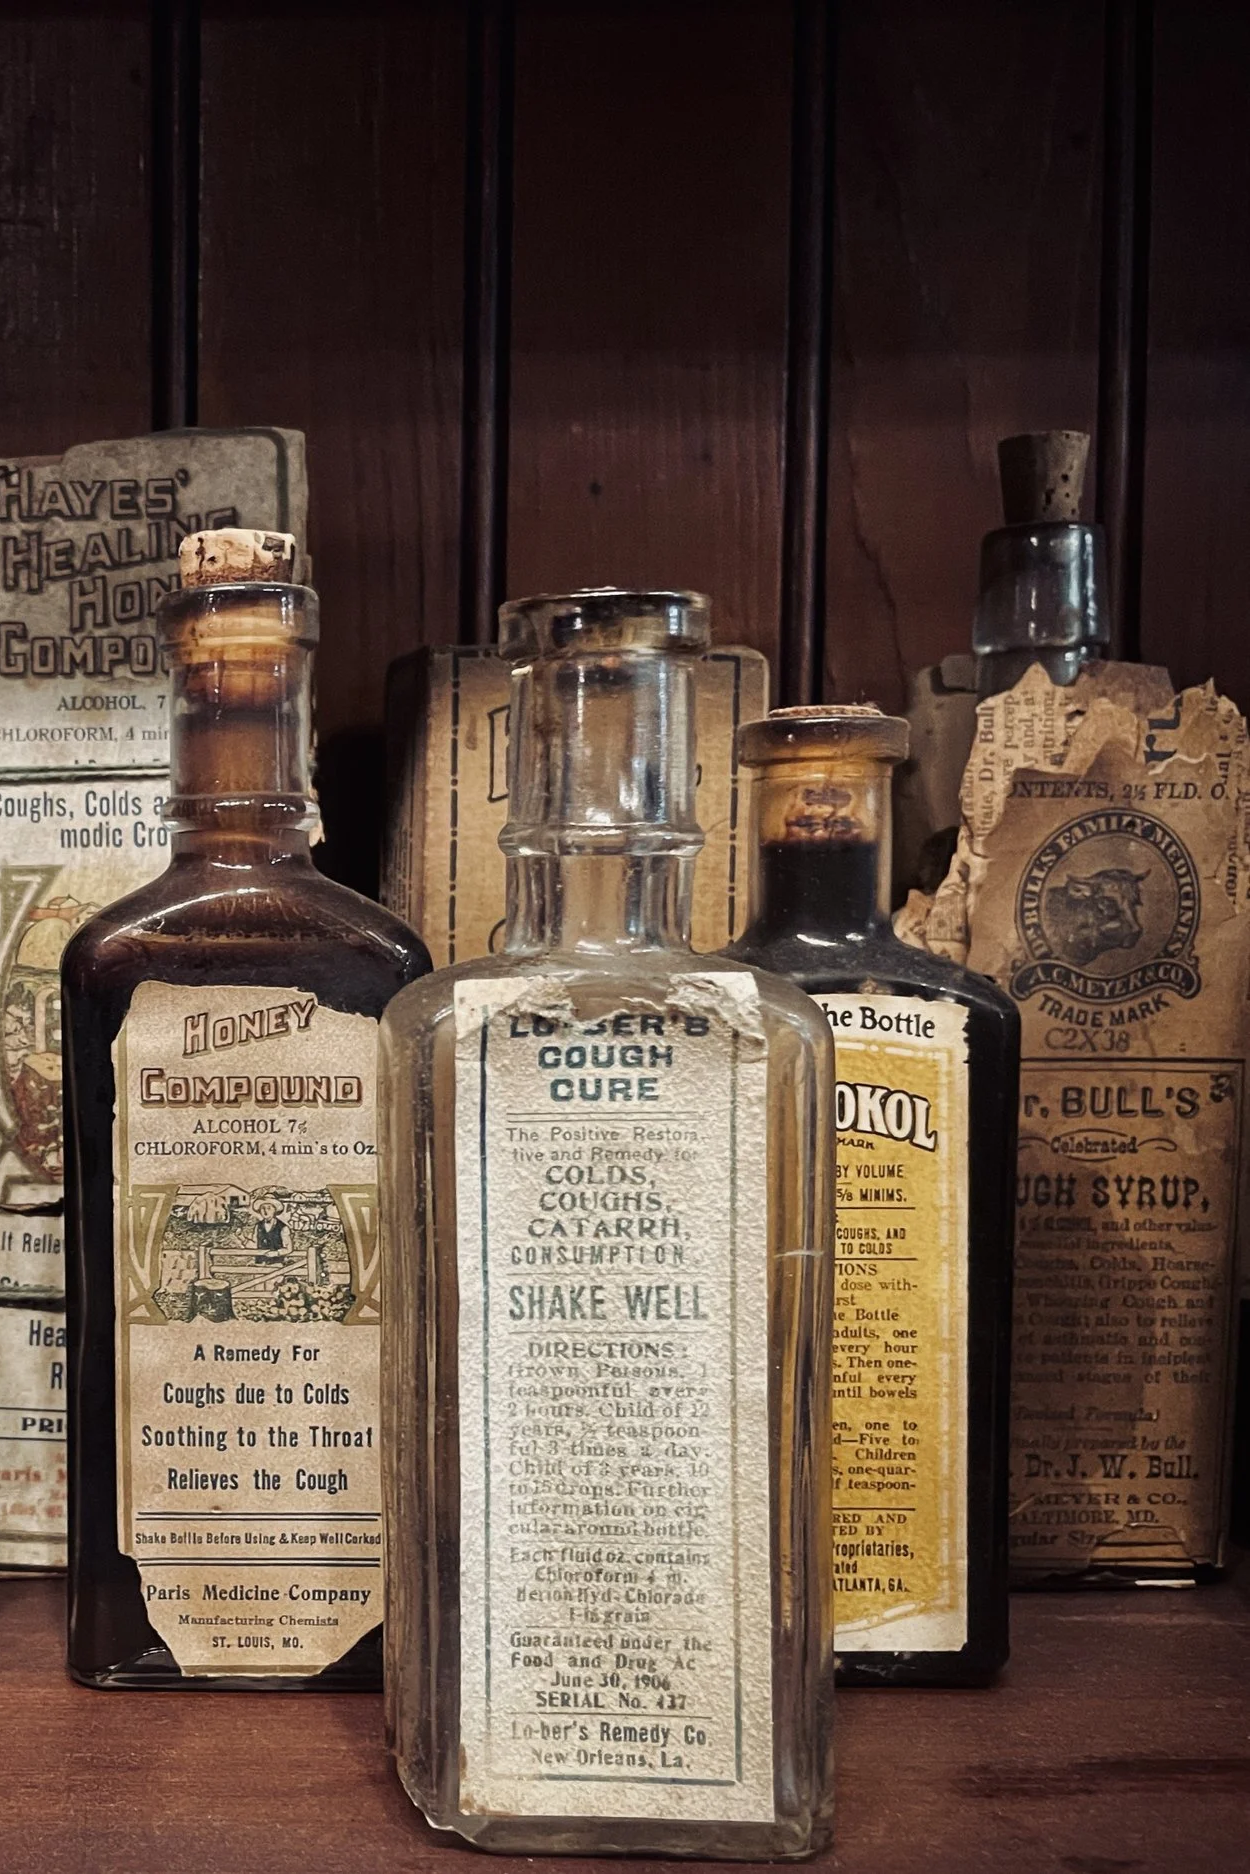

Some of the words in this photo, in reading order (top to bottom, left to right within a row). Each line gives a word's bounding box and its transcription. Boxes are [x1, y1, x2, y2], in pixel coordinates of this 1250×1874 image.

[125, 727, 135, 741] 4
[85, 790, 142, 817] Colds
[60, 822, 123, 848] modic
[1037, 994, 1103, 1027] TRADE
[1109, 994, 1170, 1026] MARK
[183, 998, 317, 1058] HONEY
[859, 1006, 936, 1039] Bottle
[537, 1045, 673, 1069] COUGH
[139, 1068, 363, 1109] COMPOUND
[550, 1077, 660, 1102] CURE
[1061, 1086, 1200, 1119] BULL'S
[193, 1119, 280, 1134] ALCOHOL
[836, 1081, 937, 1152] OKOL
[134, 1142, 266, 1157] CHLOROFORM,
[268, 1142, 277, 1155] 4
[332, 1142, 348, 1155] to
[545, 1165, 656, 1189] COLDS,
[856, 1165, 904, 1179] VOLUME
[859, 1188, 907, 1202] MINIMS.
[527, 1218, 691, 1240] CATARRH,
[886, 1228, 906, 1240] AND
[841, 1243, 854, 1255] TO
[859, 1243, 893, 1255] COLDS
[840, 1278, 872, 1291] dose
[878, 1279, 918, 1292] with-
[508, 1284, 607, 1321] SHAKE
[624, 1286, 708, 1321] WELL
[193, 1345, 206, 1361] A
[214, 1345, 280, 1364] Remedy
[292, 1346, 320, 1361] For
[884, 1341, 918, 1354] hour
[163, 1382, 225, 1408] Coughs
[235, 1384, 265, 1404] due
[275, 1384, 294, 1404] to
[303, 1384, 349, 1405] Colds
[141, 1425, 228, 1451] Soothing
[237, 1426, 257, 1447] to
[268, 1426, 299, 1447] the
[309, 1426, 373, 1447] Throat
[855, 1448, 916, 1460] Children
[1146, 1455, 1199, 1479] Bull.
[167, 1469, 239, 1490] Relieves
[254, 1469, 281, 1490] the
[296, 1469, 348, 1494] Cough
[135, 1533, 166, 1545] Shake
[170, 1532, 202, 1545] Bottle
[206, 1532, 241, 1545] Before
[244, 1533, 275, 1546] Using
[279, 1533, 289, 1544] &
[320, 1532, 343, 1544] Well
[344, 1532, 381, 1545] Corked
[146, 1585, 191, 1602] Paris
[202, 1584, 280, 1600] Medicine
[288, 1584, 371, 1605] Company
[178, 1614, 274, 1627] Manufacturing
[279, 1614, 339, 1626] Chemists
[212, 1636, 231, 1648] ST.
[237, 1637, 274, 1650] LOUIS,
[282, 1636, 303, 1649] MO.
[536, 1692, 605, 1709] SERIAL
[618, 1692, 647, 1710] No.
[600, 1723, 671, 1746] Remedy
[661, 1751, 691, 1770] La.
